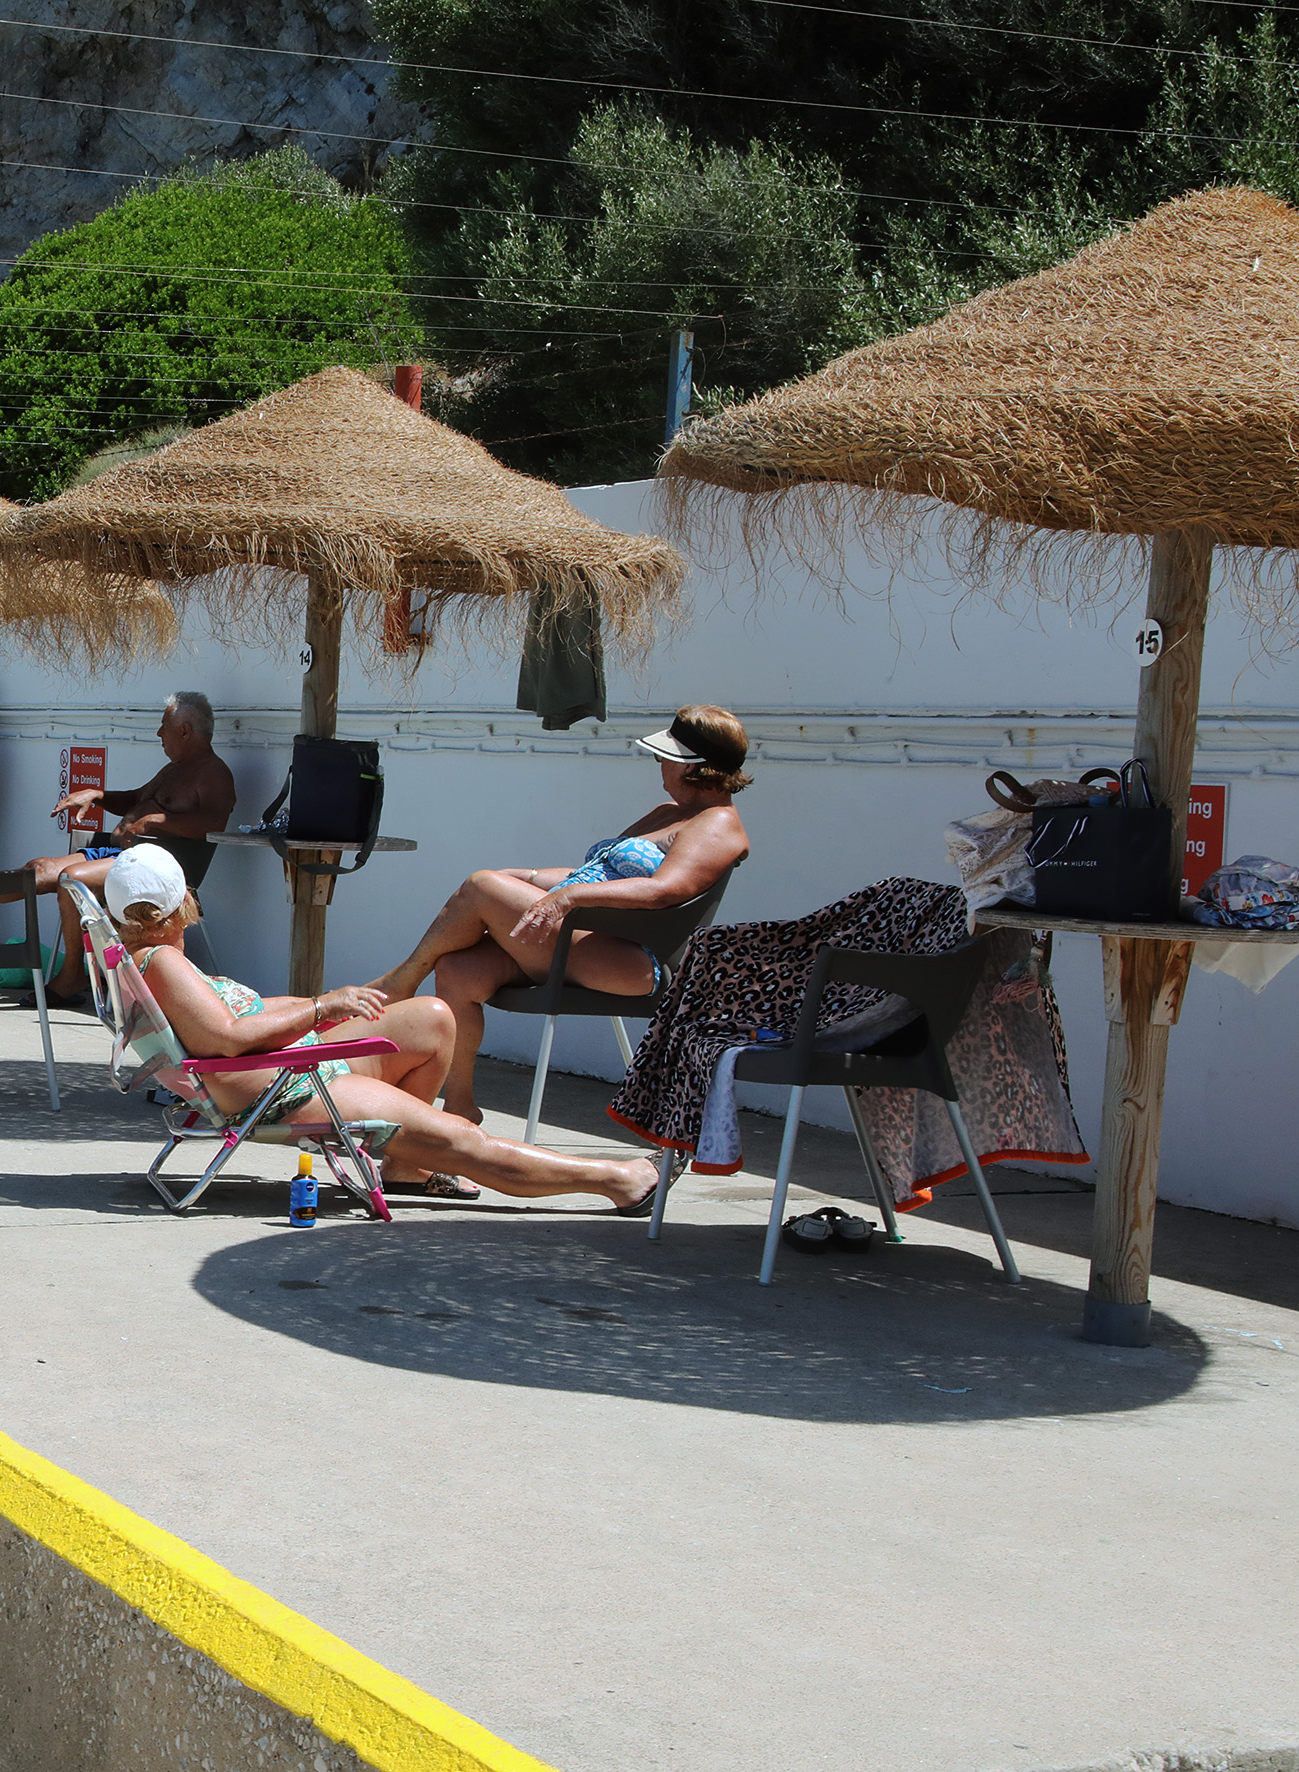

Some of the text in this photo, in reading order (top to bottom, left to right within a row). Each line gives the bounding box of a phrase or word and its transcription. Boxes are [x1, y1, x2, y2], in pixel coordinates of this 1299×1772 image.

[1135, 630, 1159, 655] 15
[299, 650, 311, 666] 14
[72, 754, 103, 766] No Smoking
[72, 774, 100, 787] No Drinking
